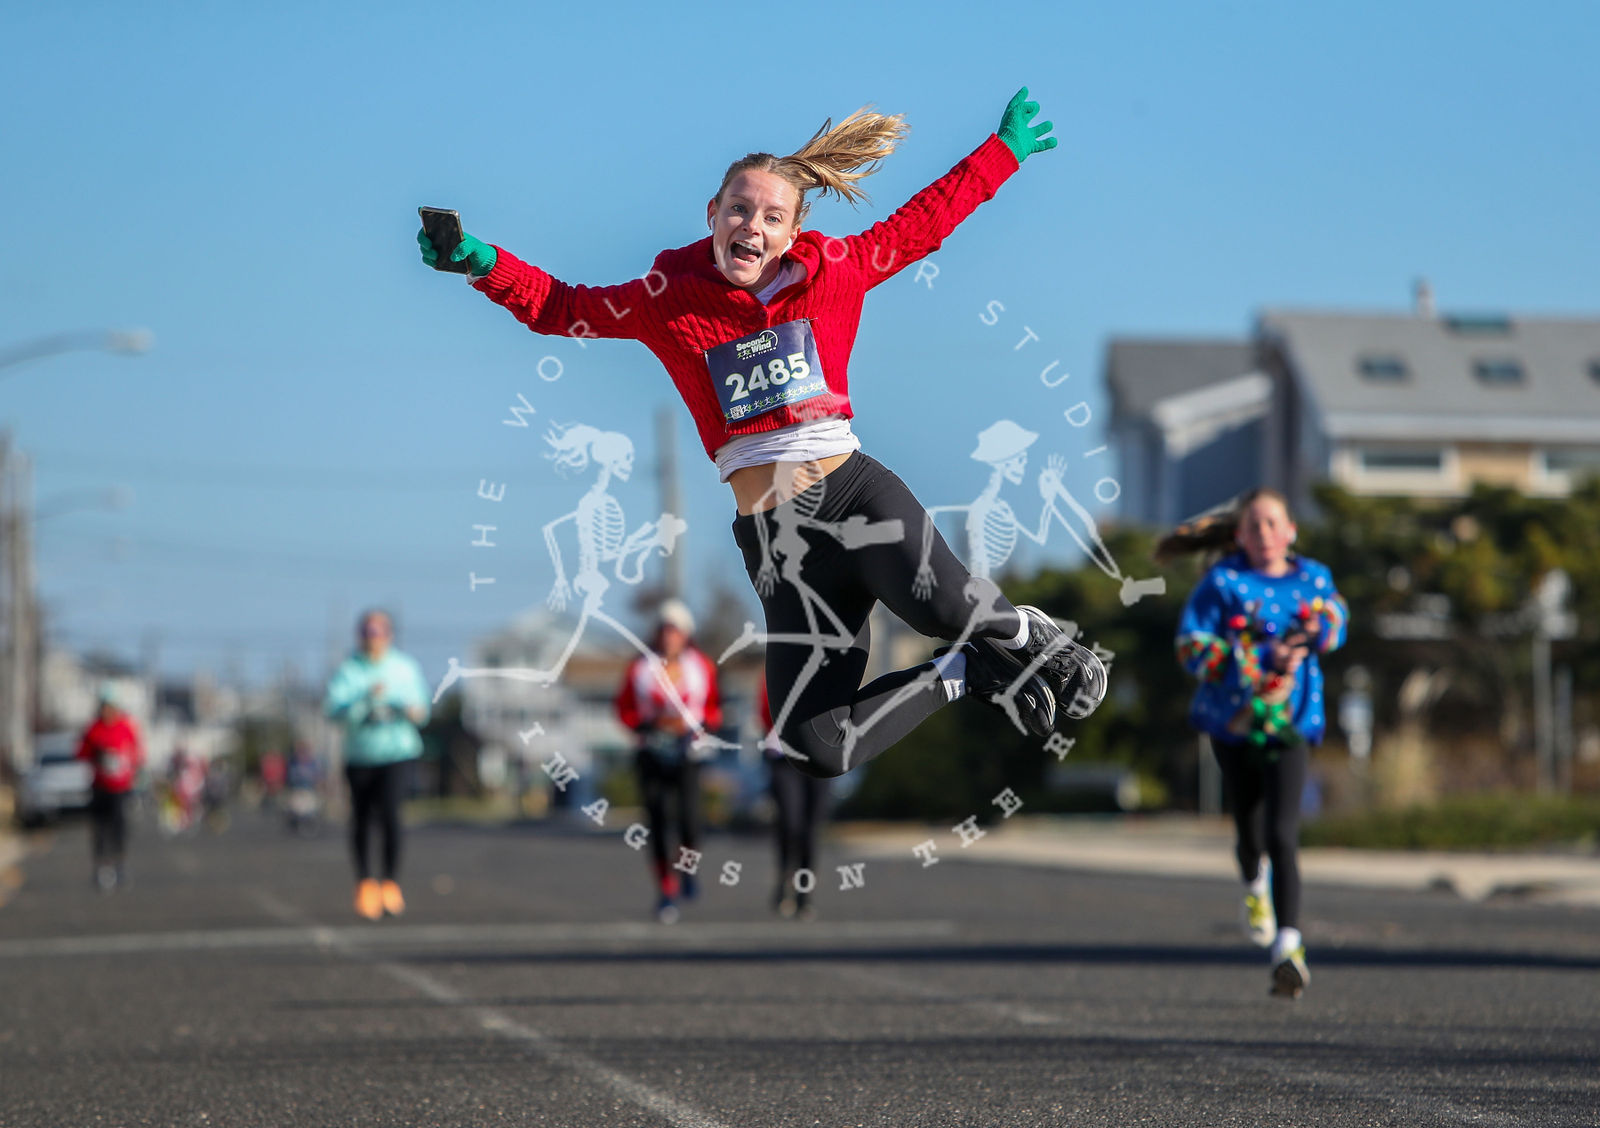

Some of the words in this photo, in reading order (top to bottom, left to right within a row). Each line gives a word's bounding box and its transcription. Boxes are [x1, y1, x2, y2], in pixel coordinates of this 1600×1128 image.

[736, 335, 765, 351] Second
[751, 340, 772, 353] Wind
[725, 352, 810, 402] 2485
